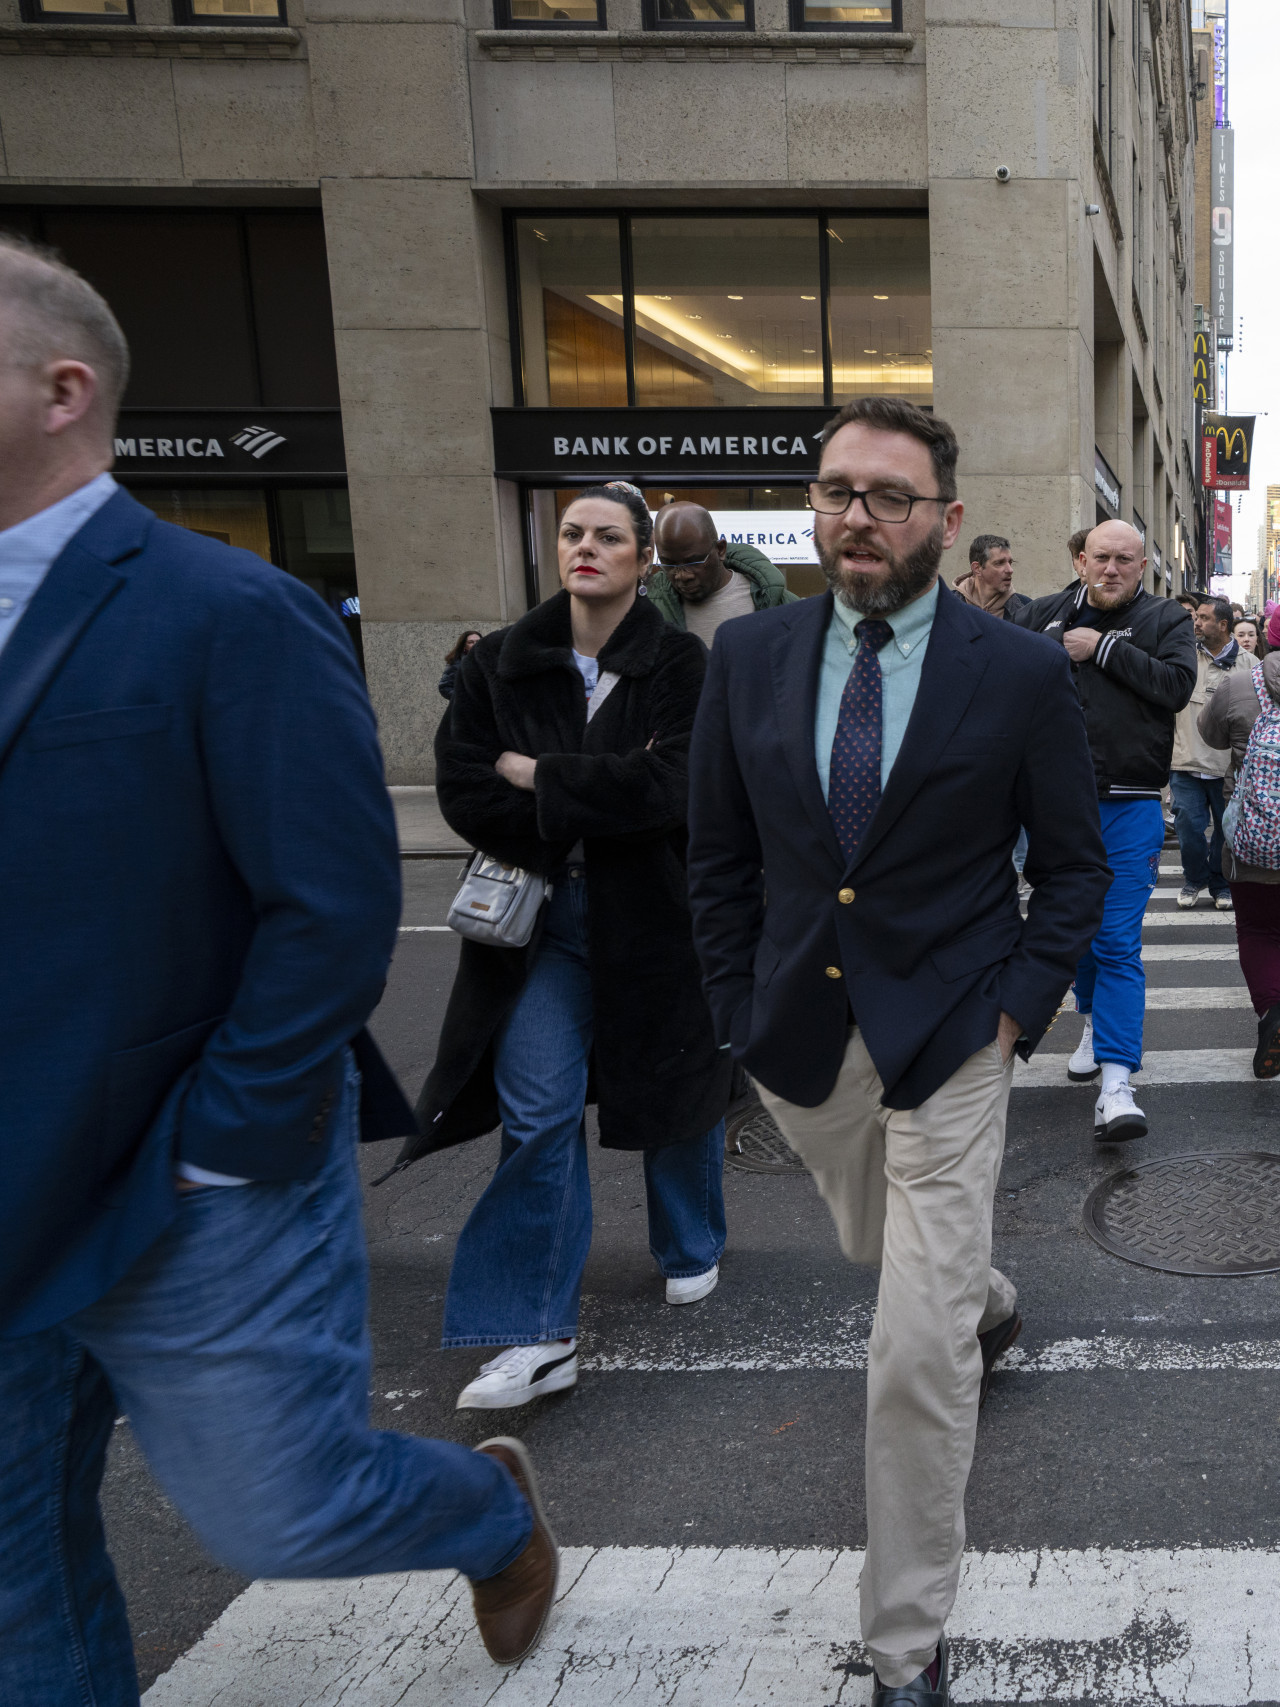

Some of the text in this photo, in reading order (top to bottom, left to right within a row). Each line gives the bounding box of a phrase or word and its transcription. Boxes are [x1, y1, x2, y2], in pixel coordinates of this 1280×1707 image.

[1212, 206, 1232, 246] 9
[114, 438, 225, 457] MERICA
[553, 436, 808, 456] BANK OF AMERICA
[1204, 441, 1212, 483] McDonald's
